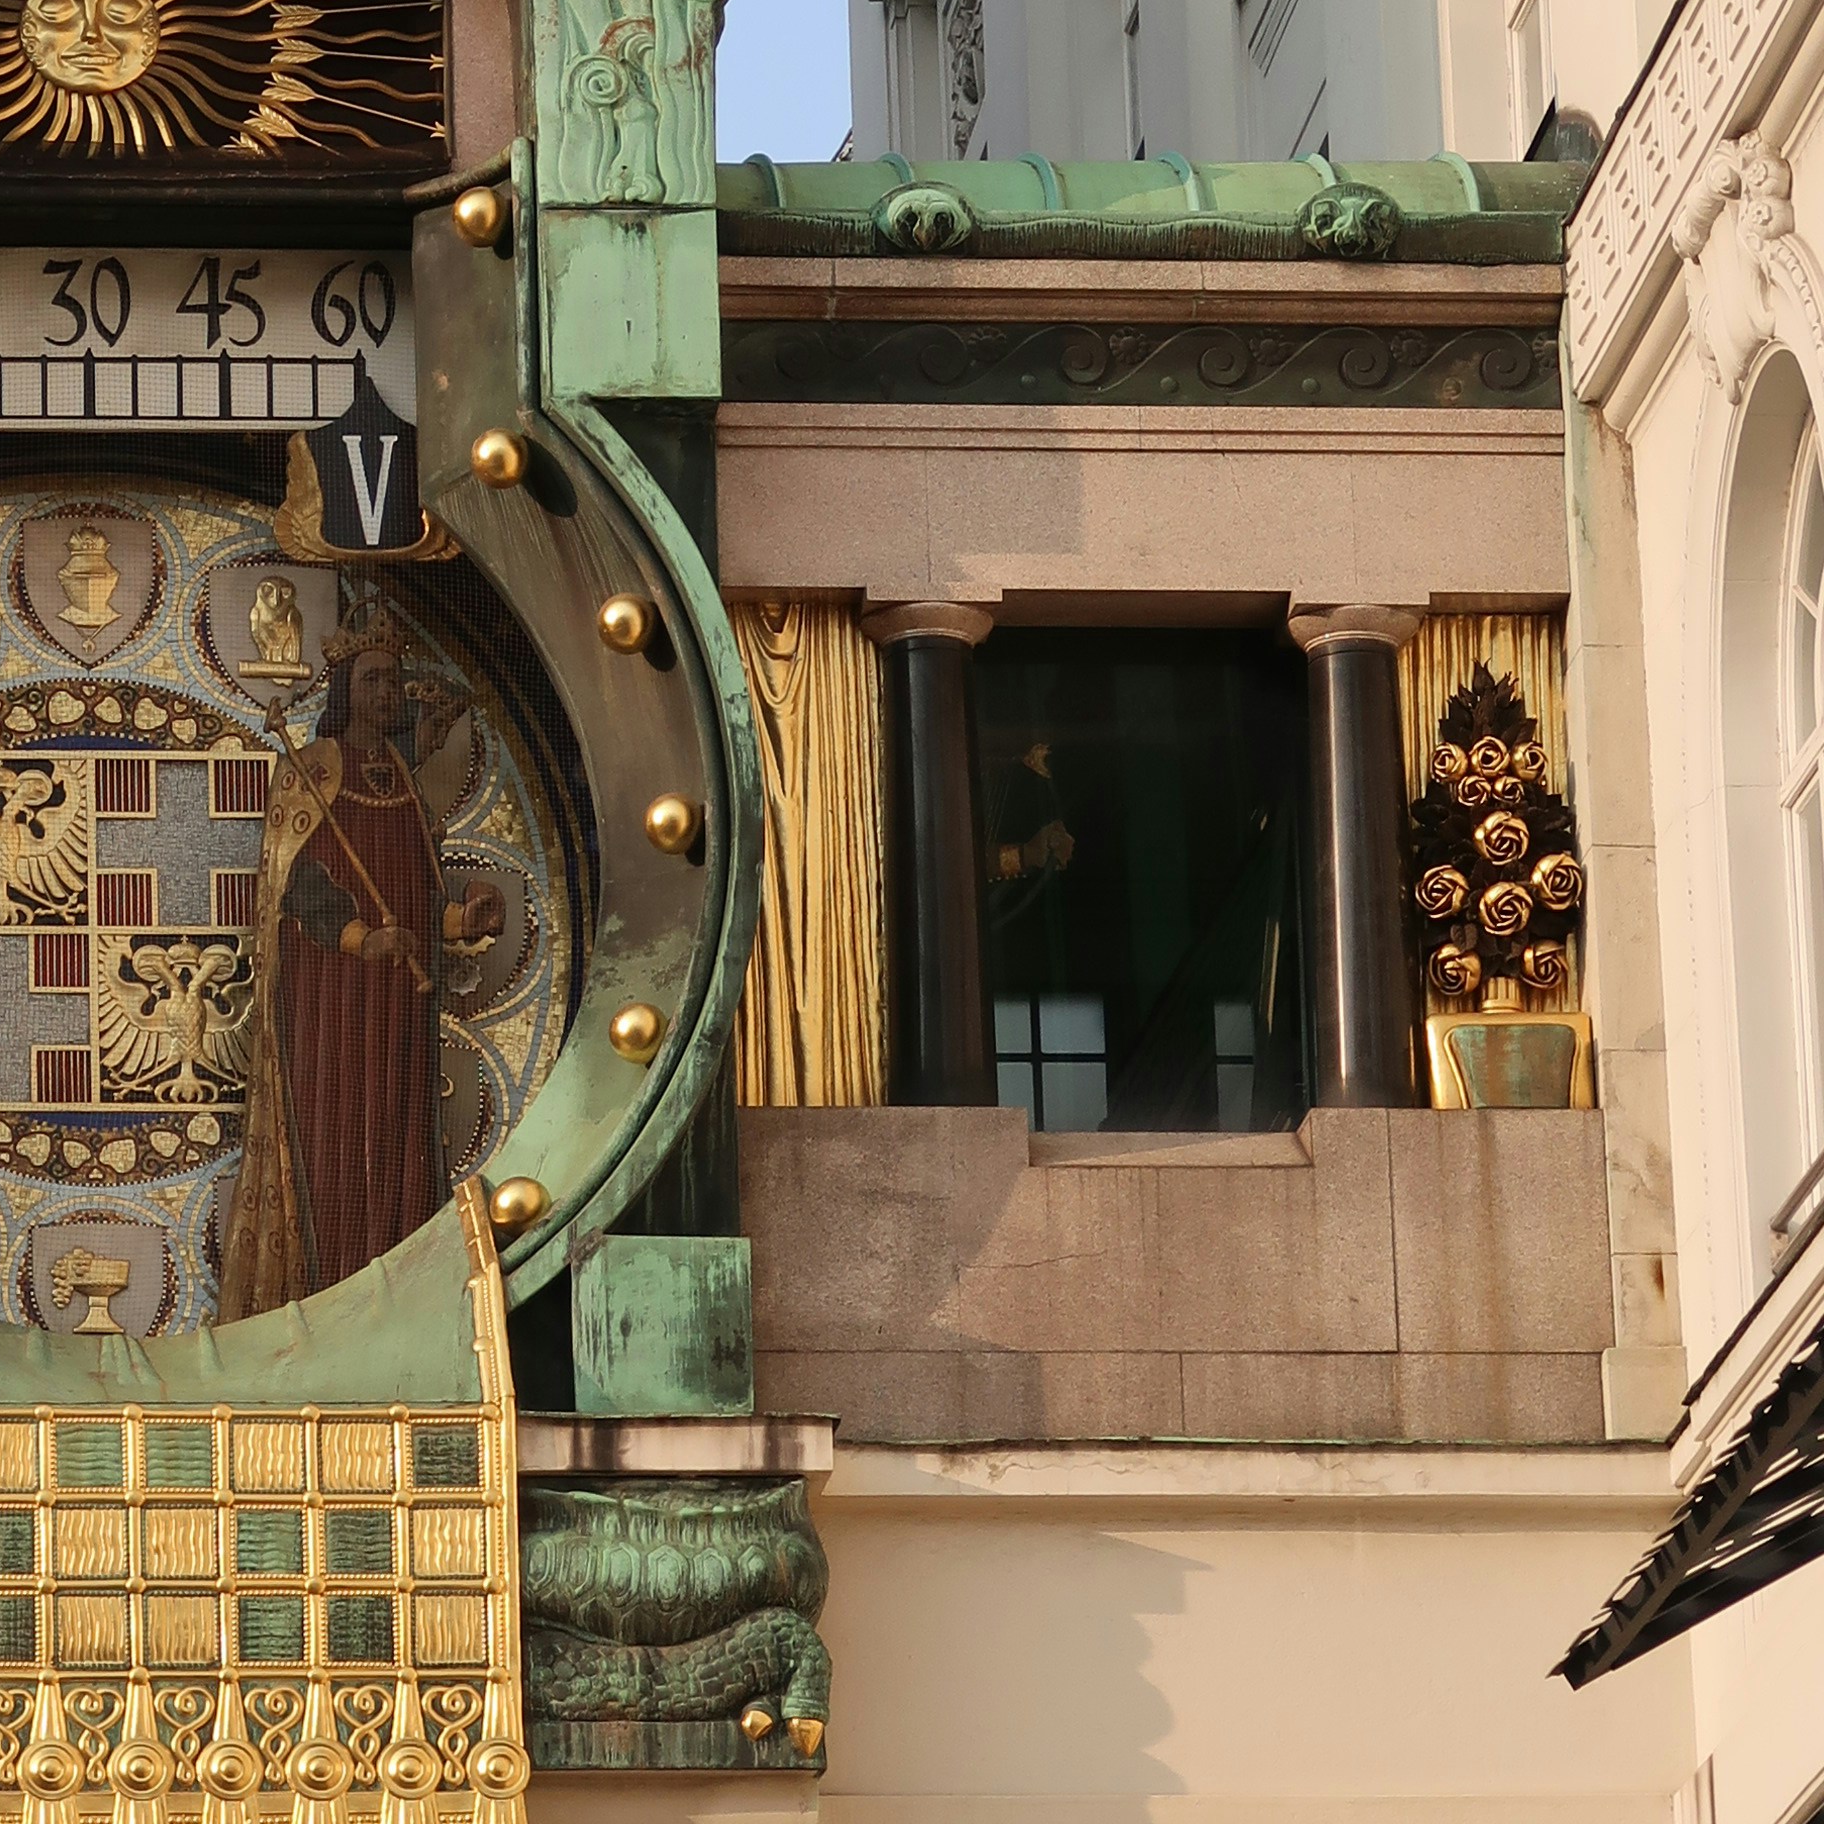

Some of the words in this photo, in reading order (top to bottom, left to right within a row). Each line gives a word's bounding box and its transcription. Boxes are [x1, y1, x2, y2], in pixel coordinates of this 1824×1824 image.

[43, 256, 131, 347] 30
[175, 257, 266, 349] 45
[311, 259, 397, 348] 60
[342, 435, 398, 545] V
